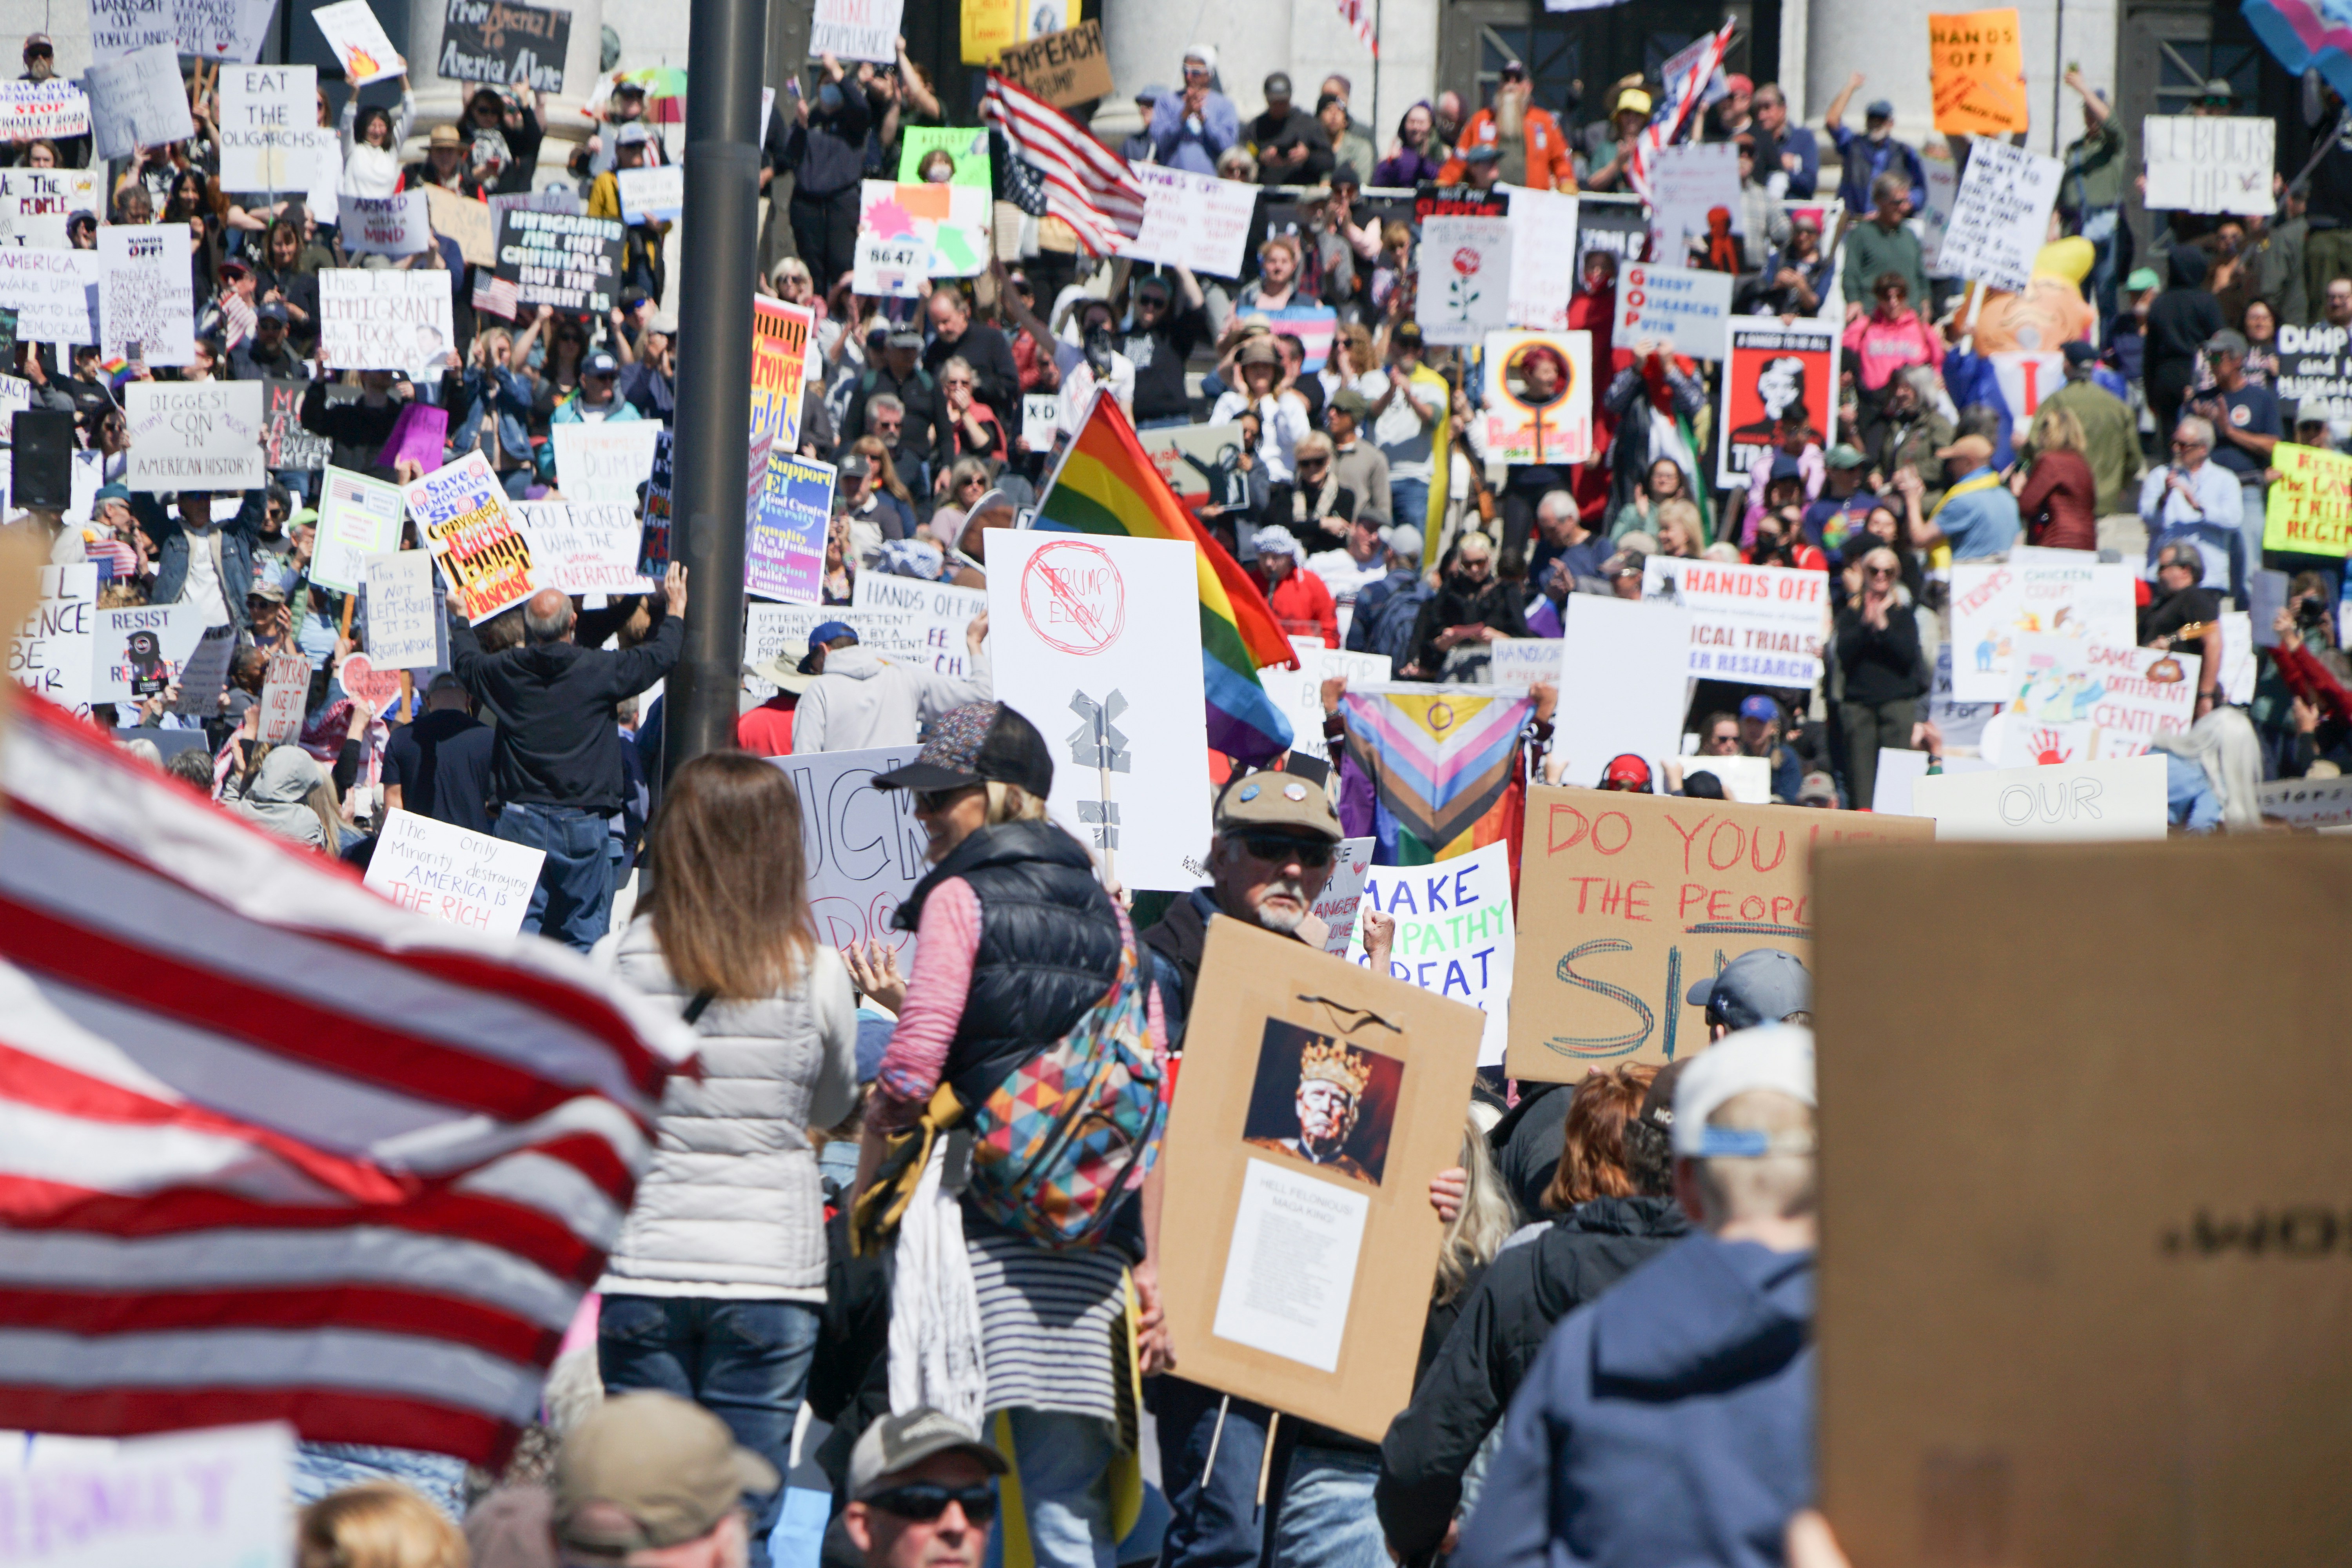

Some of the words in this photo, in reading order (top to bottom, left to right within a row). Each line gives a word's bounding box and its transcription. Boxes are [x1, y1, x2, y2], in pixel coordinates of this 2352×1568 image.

[93, 30, 137, 49] PUBLIC
[1932, 29, 2013, 45] HANDS
[1001, 23, 1103, 78] IMPEACH
[1949, 51, 1993, 68] OFF
[246, 71, 288, 93] EAT
[15, 102, 64, 115] STOP
[245, 104, 290, 126] THE
[221, 131, 314, 147] OLIGARCHS
[28, 175, 61, 194] THE
[2190, 167, 2229, 212] UP
[20, 196, 68, 215] PEOPLE
[354, 197, 407, 213] ARMED
[365, 227, 405, 244] MIND
[564, 236, 605, 256] NOT
[129, 244, 163, 257] OFF!
[501, 245, 613, 277] CRIMINALS
[871, 249, 891, 263] 86
[895, 250, 913, 265] 47
[325, 269, 358, 292] This
[402, 270, 433, 293] The
[520, 265, 558, 287] BUT
[563, 271, 597, 291] THE
[590, 292, 610, 312] IS
[2278, 323, 2348, 355] DUMP
[378, 347, 421, 369] JOB
[2298, 355, 2337, 376] and
[150, 392, 230, 411] BIGGEST
[170, 412, 212, 432] CON
[183, 434, 204, 448] IN
[137, 456, 203, 476] AMERICAN
[204, 457, 256, 475] HISTORY
[767, 453, 832, 487] Support
[425, 469, 470, 495] Save
[764, 472, 789, 495] EI
[415, 471, 491, 516] DEMOCRACY
[765, 491, 787, 508] God
[518, 505, 556, 528] YOU
[565, 504, 632, 528] FUCKED
[752, 541, 785, 560] Right
[778, 537, 822, 559] Human
[368, 561, 394, 581] This
[403, 566, 414, 578] is
[750, 557, 807, 579] nclusion
[750, 565, 788, 584] Builds
[2023, 567, 2093, 583] CHICKEN
[385, 586, 414, 600] NOT
[747, 575, 815, 601] Community
[1049, 565, 1110, 599] TRUMP
[1686, 568, 1770, 597] HANDS
[1779, 576, 1821, 602] OFF
[866, 580, 924, 611] HANDS
[934, 595, 964, 616] OFF
[111, 610, 171, 630] RESIST
[369, 601, 398, 621] LEFT
[759, 613, 815, 624] UTTERLY
[820, 613, 915, 626] INCOMPETENT
[1048, 599, 1105, 624] ELON
[383, 621, 398, 636] IT
[403, 620, 420, 631] IS
[1745, 629, 1818, 653] TRIALS
[1544, 645, 1564, 662] OF
[2087, 645, 2141, 671] SAME
[266, 655, 312, 686] DEMOCRACY
[1321, 655, 1376, 682] STOP
[1717, 653, 1814, 679] RESEARCH
[2103, 673, 2189, 704] DIFFERENT
[272, 690, 289, 710] USE
[290, 690, 301, 711] IT
[1998, 776, 2104, 828] OUR
[396, 818, 426, 841] The
[1548, 802, 1632, 858] DO
[1664, 813, 1786, 875] YOU
[391, 840, 453, 872] Minority
[466, 862, 528, 897] destroying
[1182, 863, 1202, 878] FELON
[406, 865, 487, 900] AMERICA
[1363, 864, 1479, 915] MAKE
[388, 880, 433, 915] THE
[1568, 876, 1655, 923] THE
[1679, 882, 1813, 927] PEOPL
[1260, 1176, 1288, 1195] HELL
[1289, 1185, 1354, 1216] FELONIOUS!
[1272, 1195, 1305, 1215] MAGA
